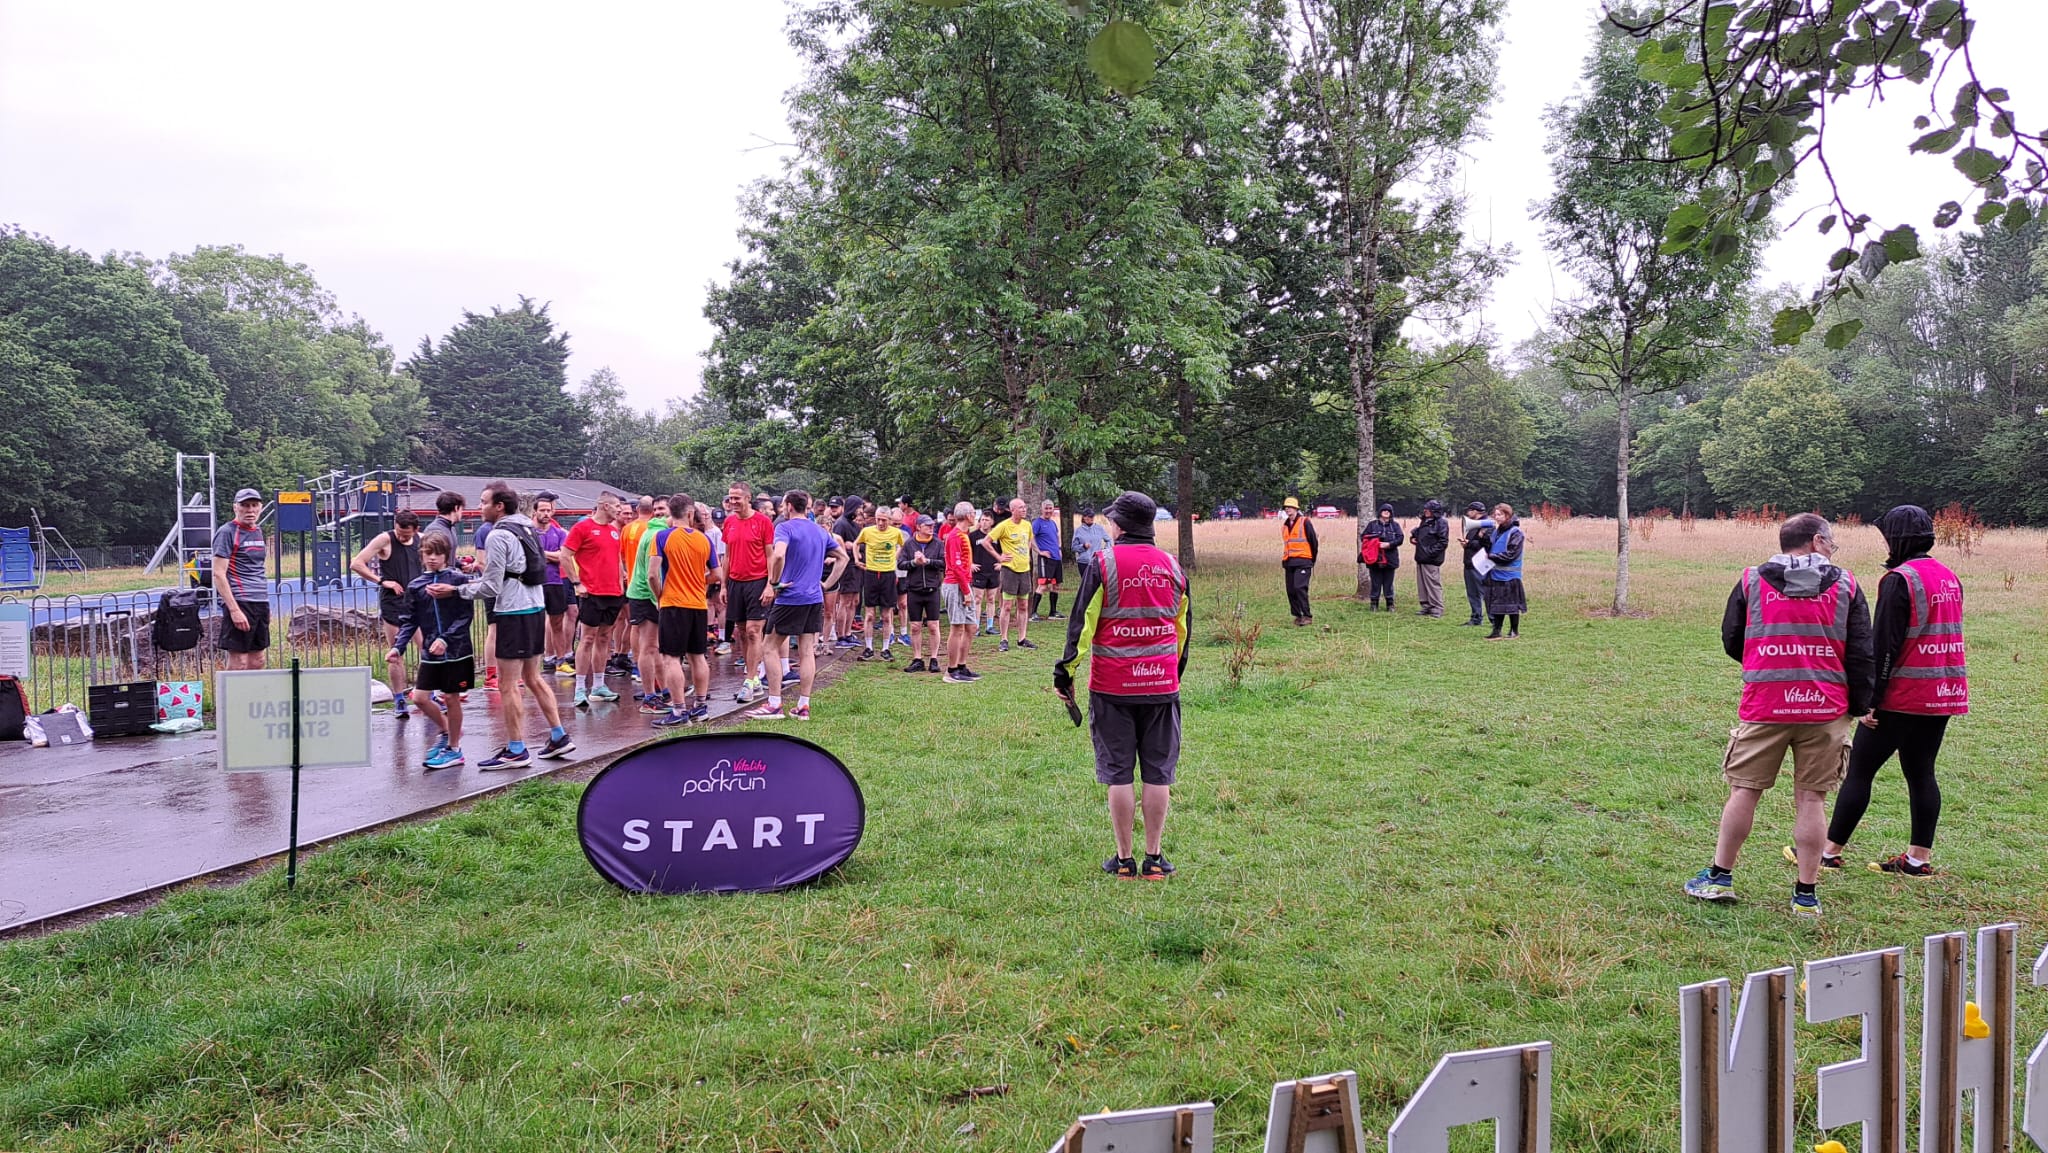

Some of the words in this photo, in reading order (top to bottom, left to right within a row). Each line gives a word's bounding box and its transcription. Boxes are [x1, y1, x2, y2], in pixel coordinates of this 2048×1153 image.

[1112, 623, 1176, 637] VOLUNTEE
[1757, 644, 1837, 658] VOLUNTEE
[1132, 662, 1166, 679] Vitality
[1783, 685, 1827, 706] Vitality
[1936, 682, 1966, 699] Vitality
[733, 758, 767, 775] Vitality
[682, 759, 766, 797] parkrun
[621, 813, 825, 852] START
